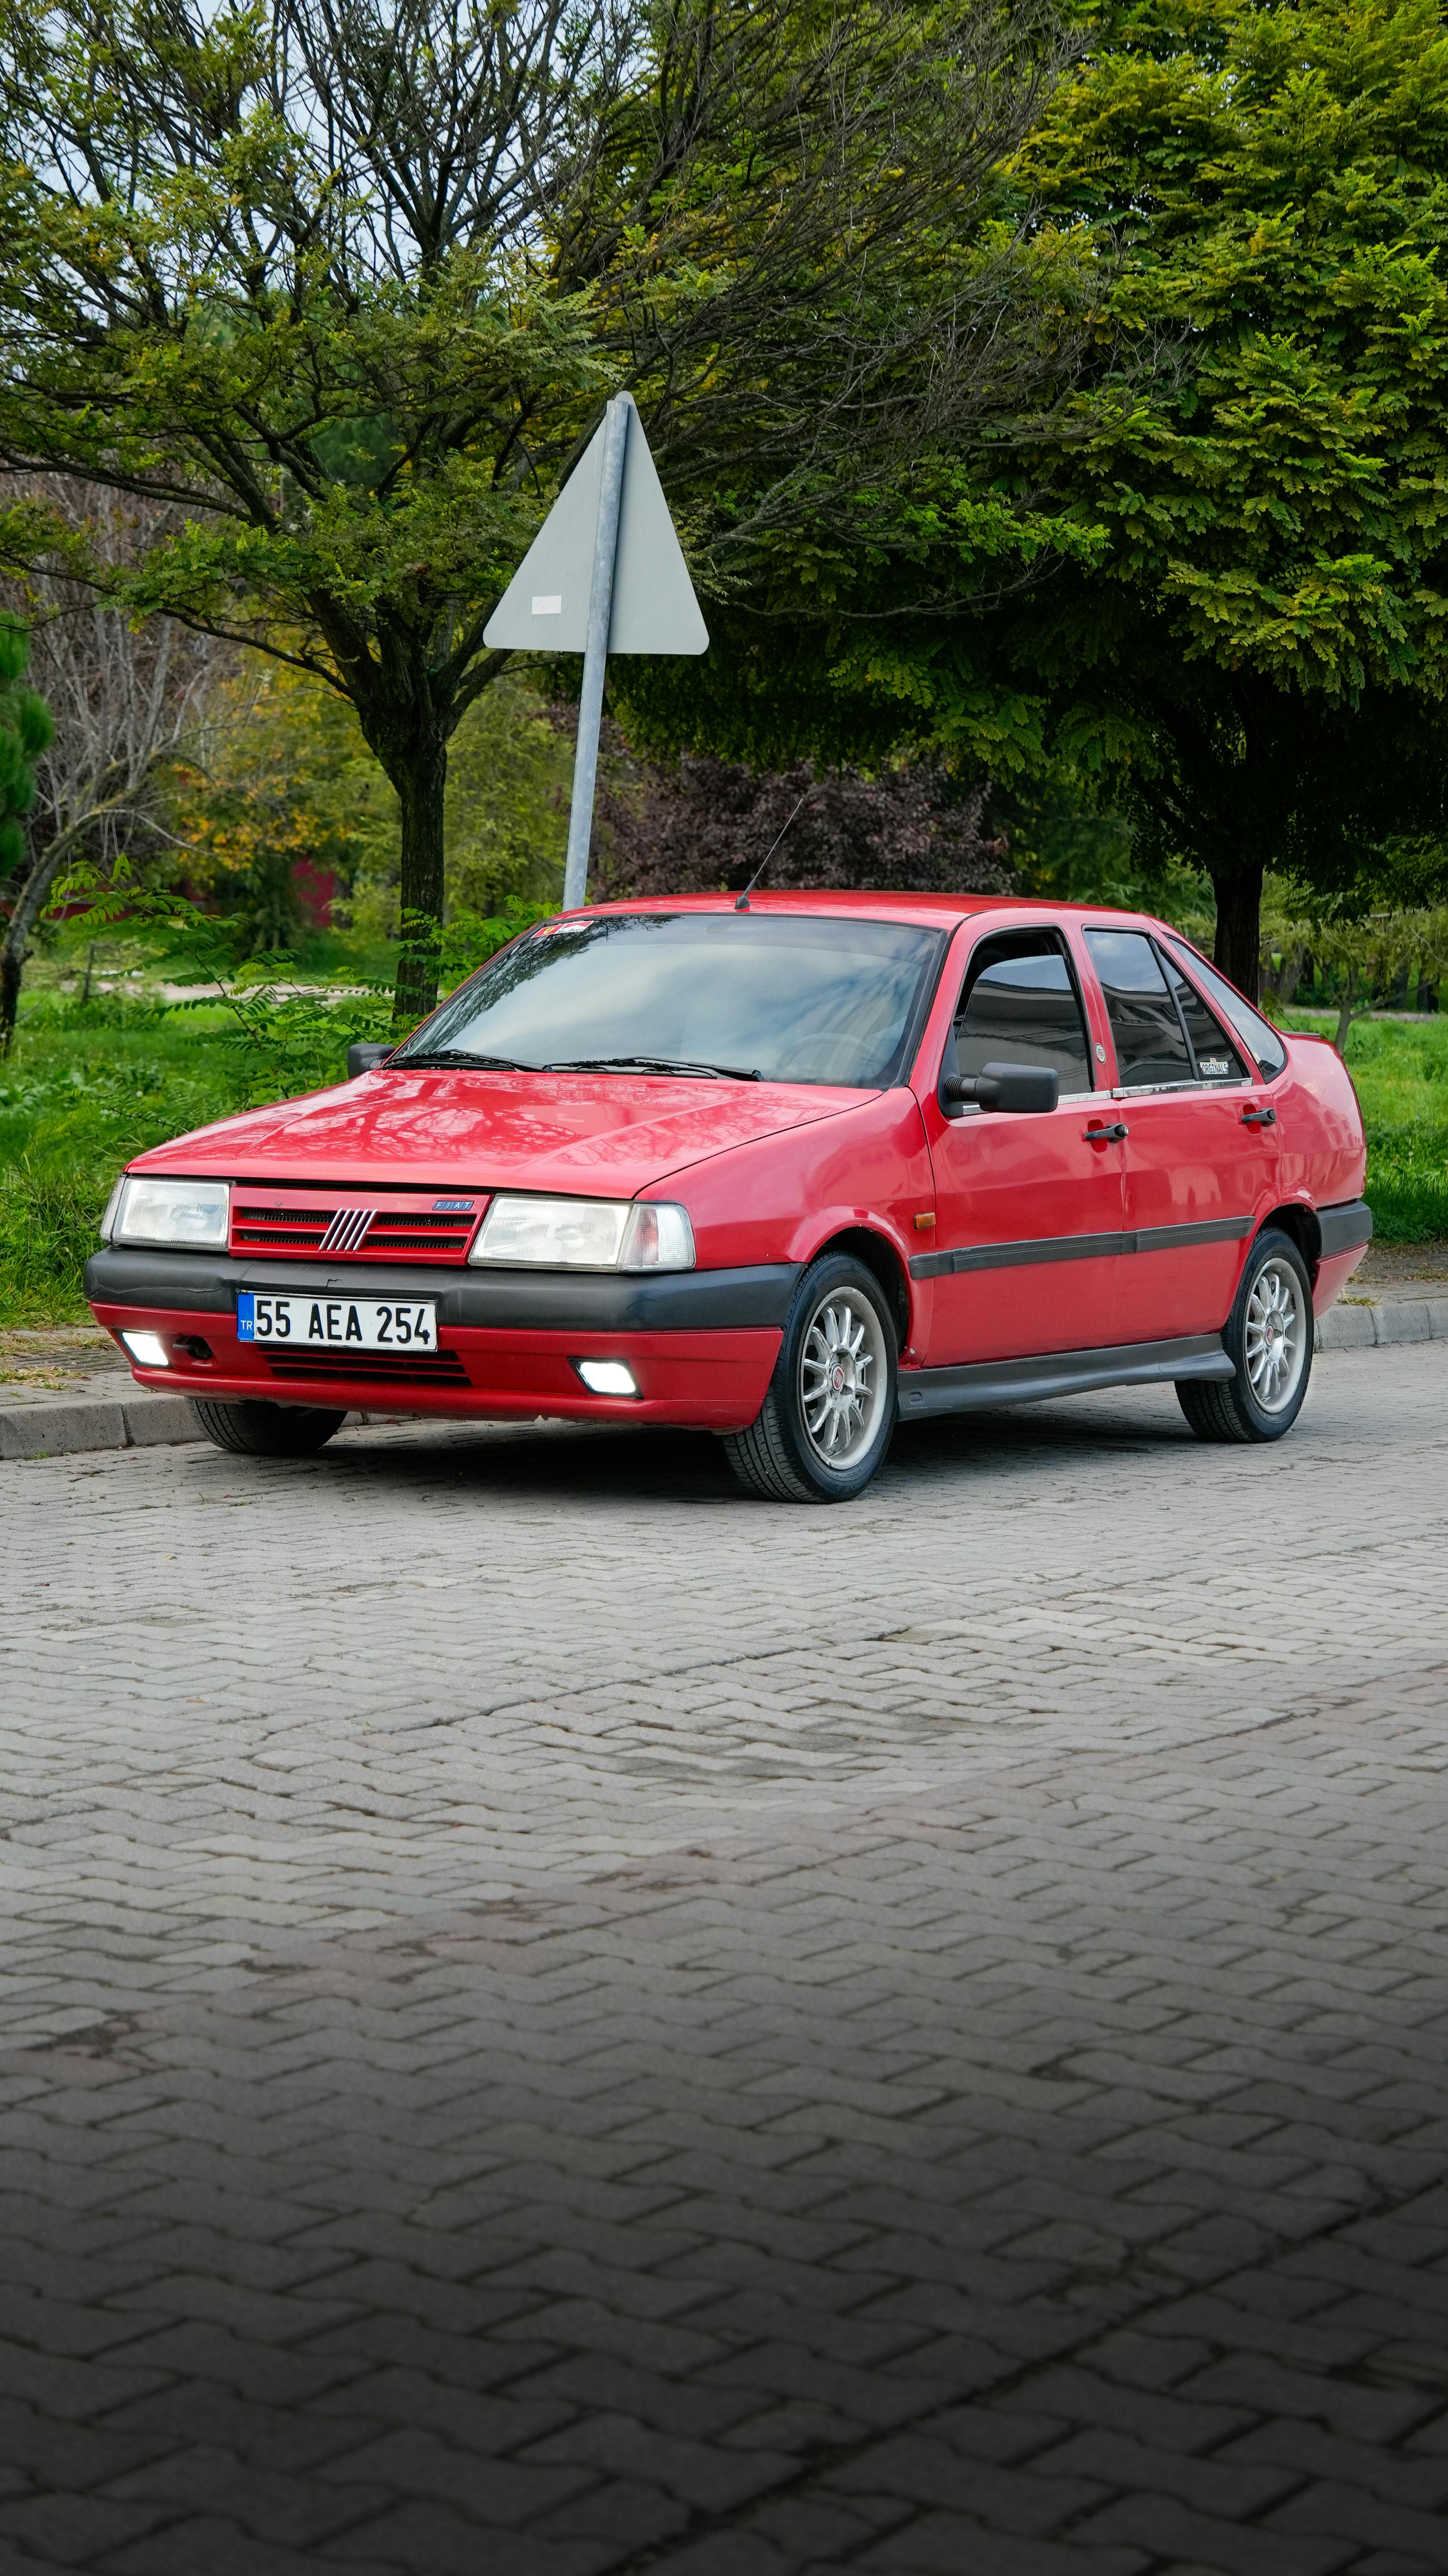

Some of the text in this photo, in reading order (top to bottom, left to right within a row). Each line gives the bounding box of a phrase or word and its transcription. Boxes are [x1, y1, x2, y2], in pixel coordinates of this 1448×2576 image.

[1202, 1063, 1228, 1073] ORGINALS
[241, 1300, 430, 1345] TR 55 AEA 254
